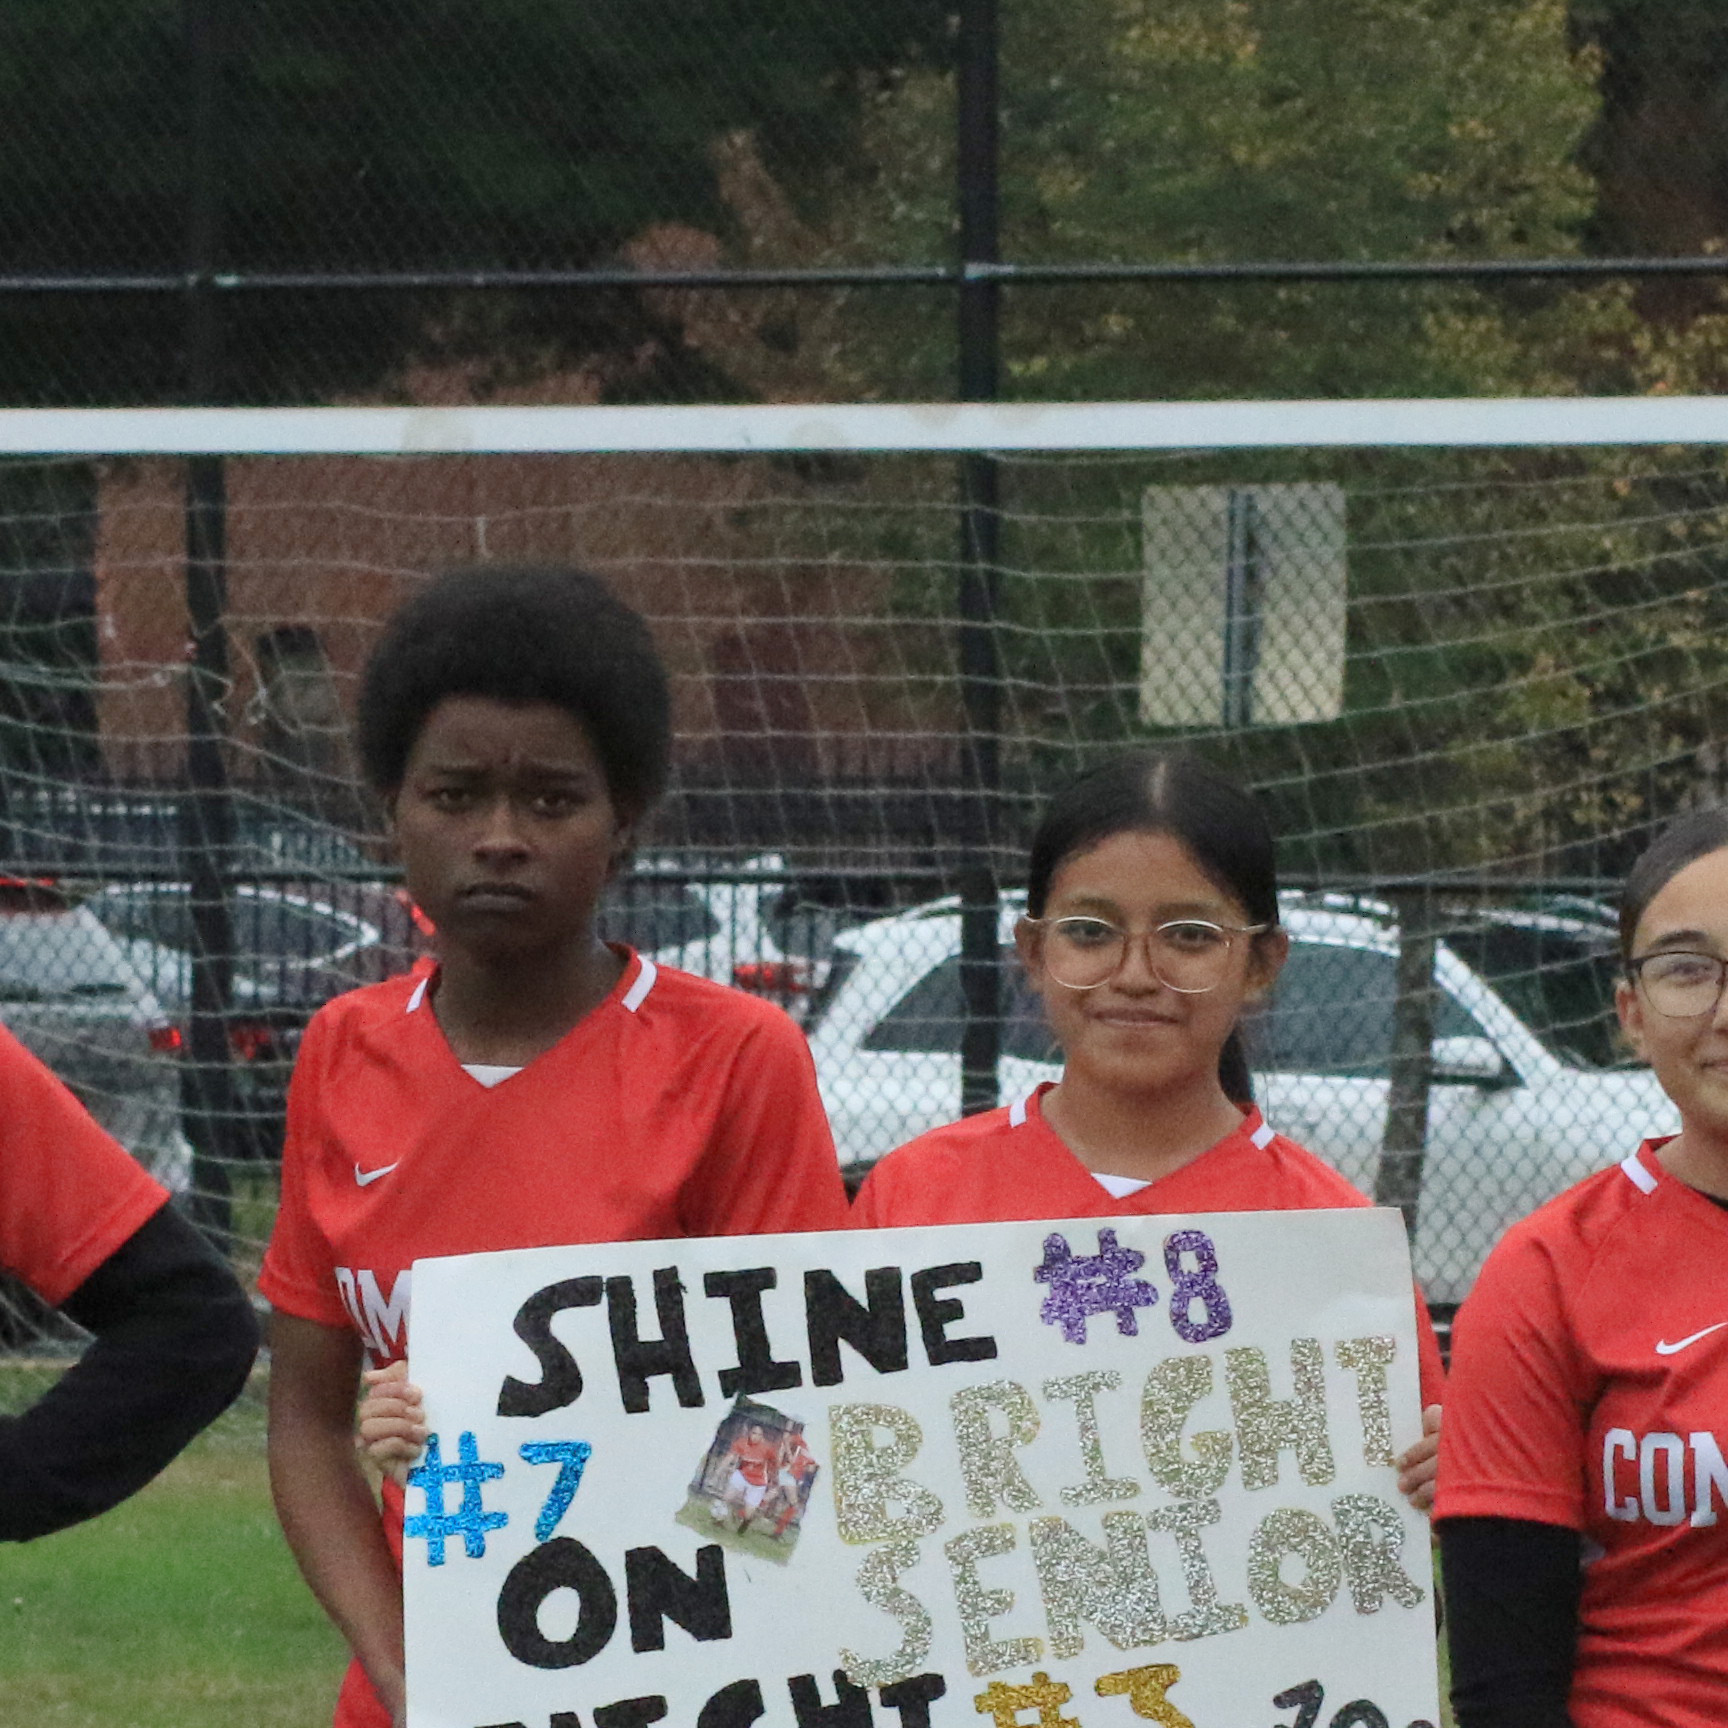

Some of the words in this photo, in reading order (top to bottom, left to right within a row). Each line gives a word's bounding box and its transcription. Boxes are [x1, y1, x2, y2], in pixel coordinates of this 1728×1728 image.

[496, 1261, 997, 1417] SHINE
[1033, 1227, 1233, 1344] #8
[405, 1431, 592, 1566] #7
[828, 1334, 1396, 1545] BRIGHT
[497, 1536, 732, 1669] ON
[839, 1493, 1425, 1688] SENIOR
